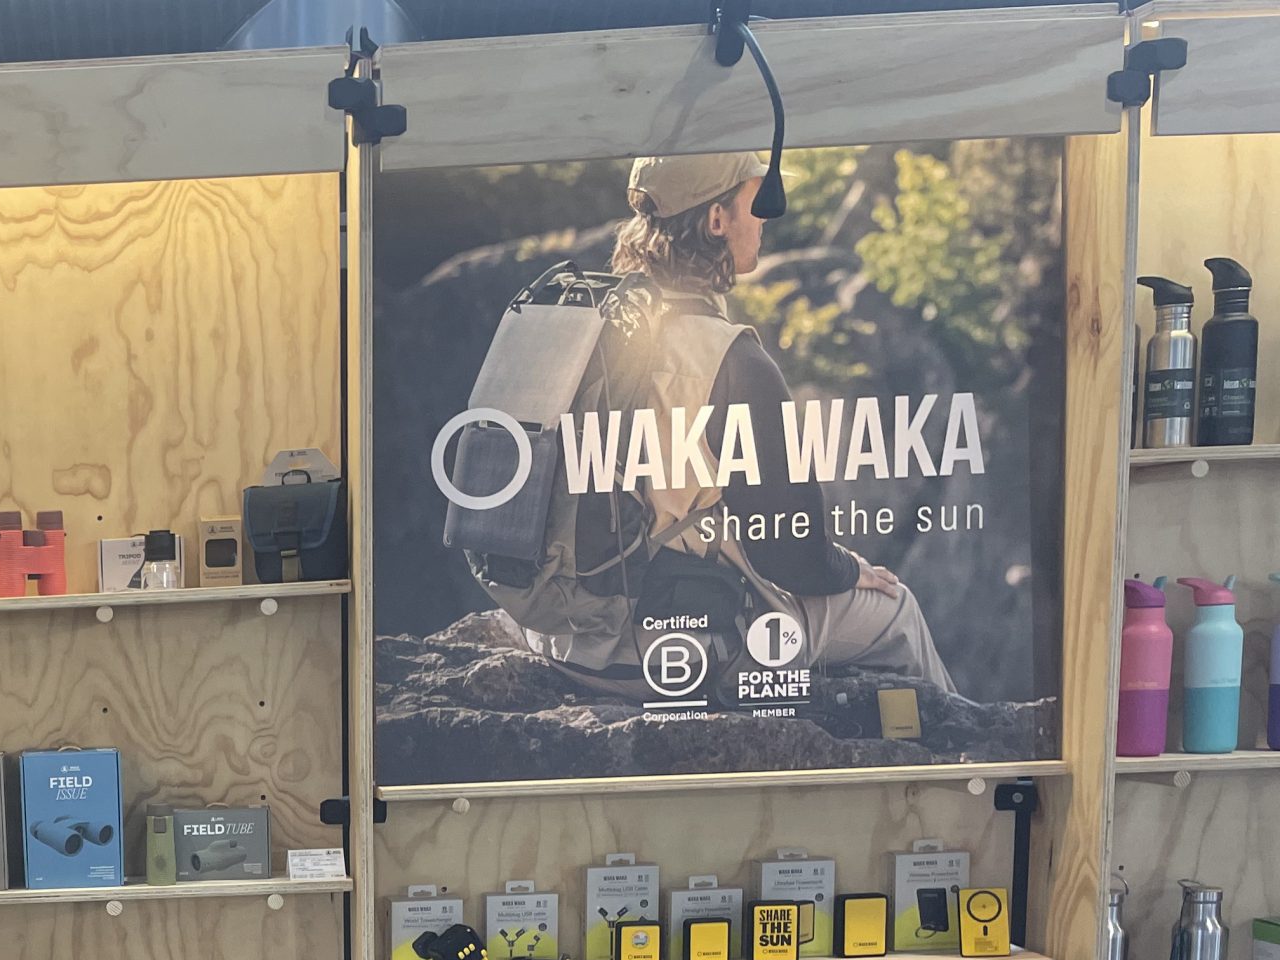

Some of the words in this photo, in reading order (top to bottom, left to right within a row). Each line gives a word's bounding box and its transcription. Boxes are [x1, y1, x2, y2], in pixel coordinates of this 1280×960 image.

[560, 404, 760, 494] WAKA
[781, 392, 986, 483] WAKA
[699, 506, 810, 542] share
[831, 502, 893, 536] the
[917, 503, 985, 532] sun
[643, 615, 707, 630] Certified
[765, 618, 797, 660] 1%
[661, 646, 691, 684] B
[738, 671, 773, 684] FOR
[777, 670, 810, 682] THE
[738, 683, 810, 698] PLANET
[643, 710, 707, 722] Corporation
[752, 708, 795, 718] MEMBER
[49, 776, 93, 788] FIELD
[56, 788, 88, 800] ISSUE
[183, 824, 224, 836] FIELD
[226, 823, 254, 835] TUBE
[759, 909, 792, 921] SHARE
[759, 922, 792, 933] THE
[759, 934, 792, 946] SUN
